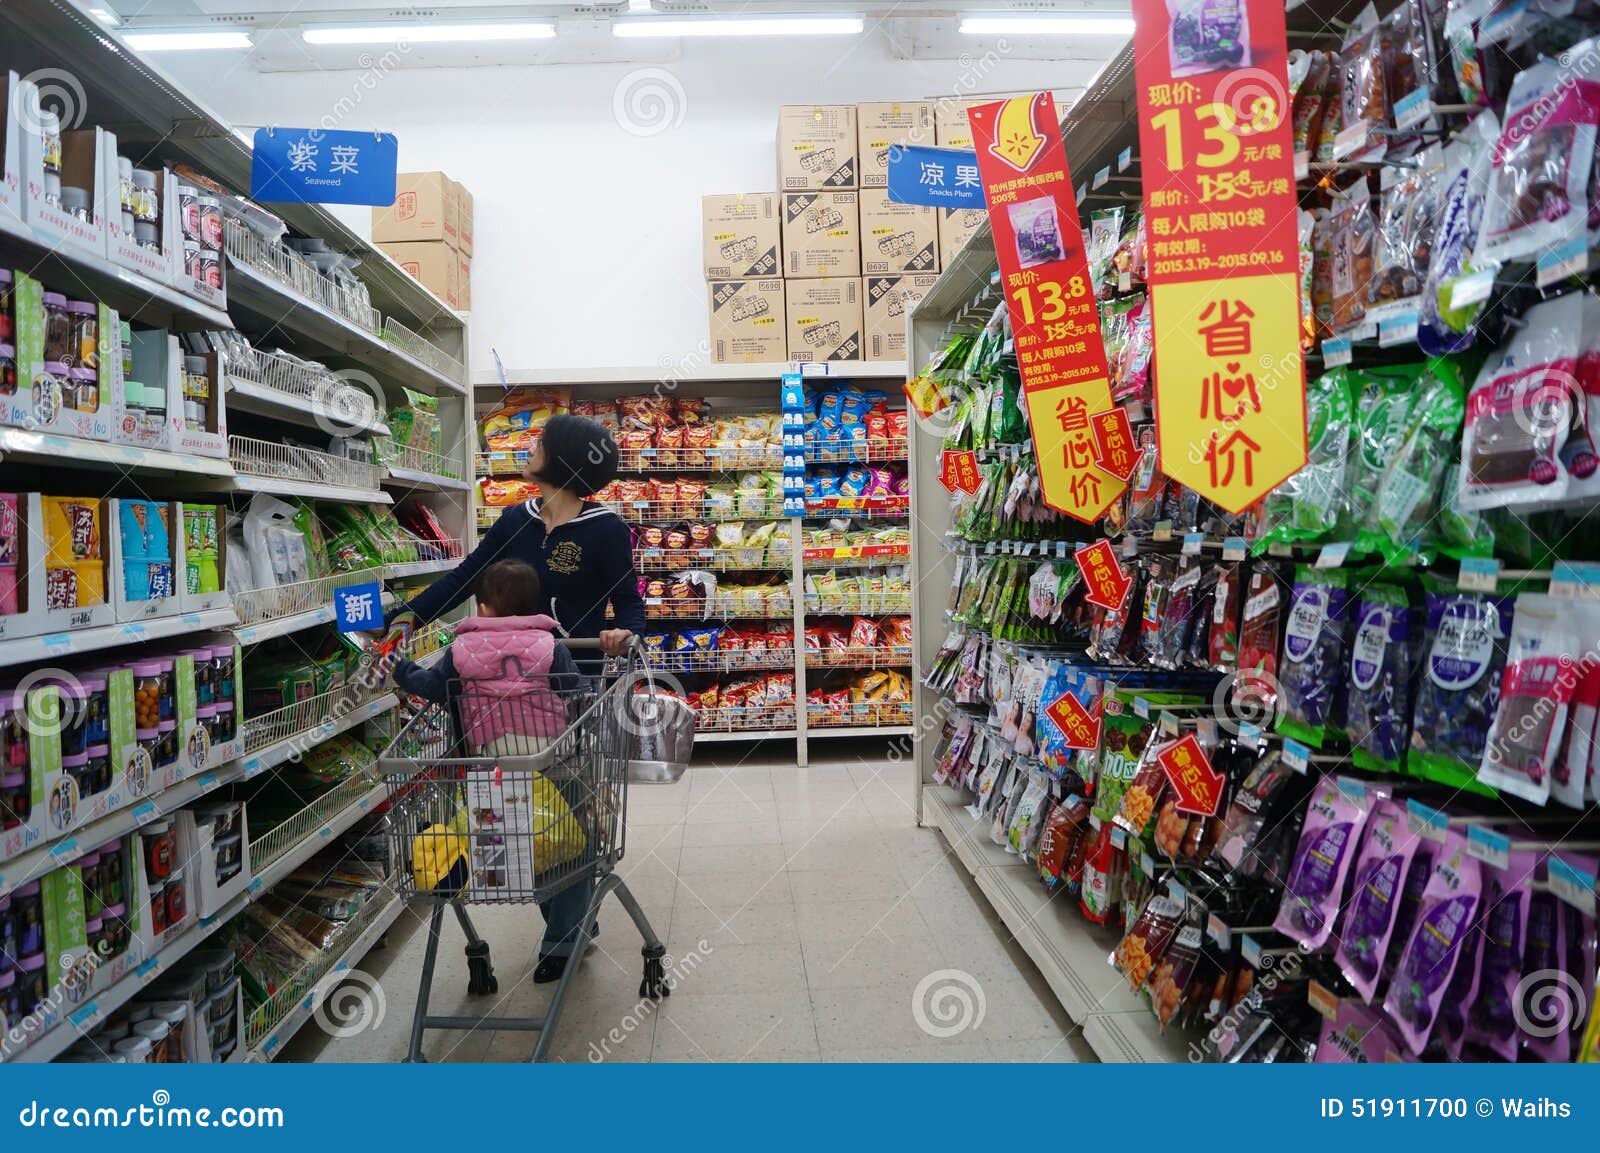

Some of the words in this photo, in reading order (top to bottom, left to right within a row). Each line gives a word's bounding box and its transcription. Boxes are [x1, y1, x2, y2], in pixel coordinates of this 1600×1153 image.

[289, 141, 360, 174] 紫菜
[304, 176, 341, 187] Seaweed
[919, 161, 981, 188] 凉果
[928, 187, 953, 197] Snacks
[954, 189, 973, 198] Plum
[1152, 208, 1266, 236] 每人限购10袋
[1021, 341, 1087, 363] 每人限购10袋
[1198, 299, 1261, 488] 省心价
[1056, 396, 1101, 508] 省心价
[1101, 415, 1128, 466] 省心价
[344, 592, 373, 624] 新
